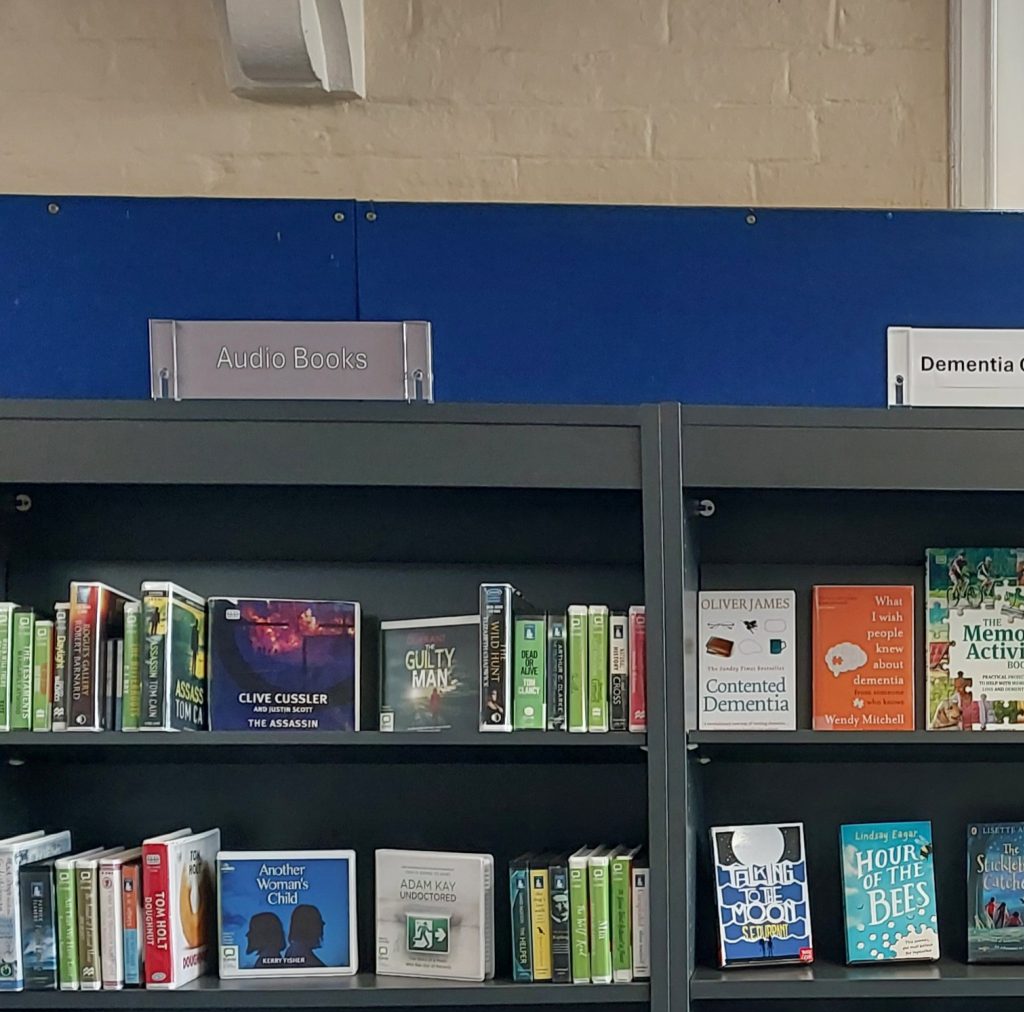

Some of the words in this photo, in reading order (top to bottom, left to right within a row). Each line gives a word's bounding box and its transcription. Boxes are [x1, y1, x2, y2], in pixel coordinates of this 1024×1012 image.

[216, 346, 286, 369] Audio
[293, 346, 369, 370] Books
[921, 356, 1014, 372] Dementia
[701, 598, 747, 609] OLIVER
[749, 598, 790, 609] JAMES
[875, 596, 903, 606] What
[878, 612, 903, 622] wish
[983, 618, 1001, 626] THE
[867, 628, 903, 640] people
[876, 643, 903, 653] knew
[405, 648, 455, 670] GUILTY
[521, 650, 538, 659] DEAD
[525, 658, 534, 667] OR
[873, 660, 903, 669] about
[520, 666, 539, 675] ALIVE
[412, 669, 448, 688] MAN
[523, 678, 536, 686] TOM
[853, 675, 904, 685] dementia
[518, 686, 540, 695] CLANCY
[706, 677, 786, 694] Contented
[239, 693, 272, 704] CLIVE
[275, 693, 328, 704] CUSSLER
[703, 694, 789, 713] Dementia
[248, 719, 266, 727] THE
[269, 720, 319, 728] ASSASSIN
[825, 715, 859, 727] Wendy
[862, 714, 904, 724] Mitchell
[855, 831, 888, 843] Lindsay
[892, 830, 918, 841] Eagar
[1003, 843, 1019, 855] The
[856, 845, 918, 879] HOUR
[259, 863, 305, 876] Another
[863, 871, 882, 890] OF
[887, 862, 925, 884] THE
[257, 878, 309, 890] Woman's
[400, 878, 431, 890] ADAM
[434, 881, 456, 891] KAY
[268, 892, 298, 904] Child
[400, 891, 457, 902] UNDOCTORED
[155, 892, 165, 916] TOM
[867, 881, 931, 926] BEES
[144, 896, 154, 945] DOUGHNUT
[156, 919, 167, 950] HOLT
